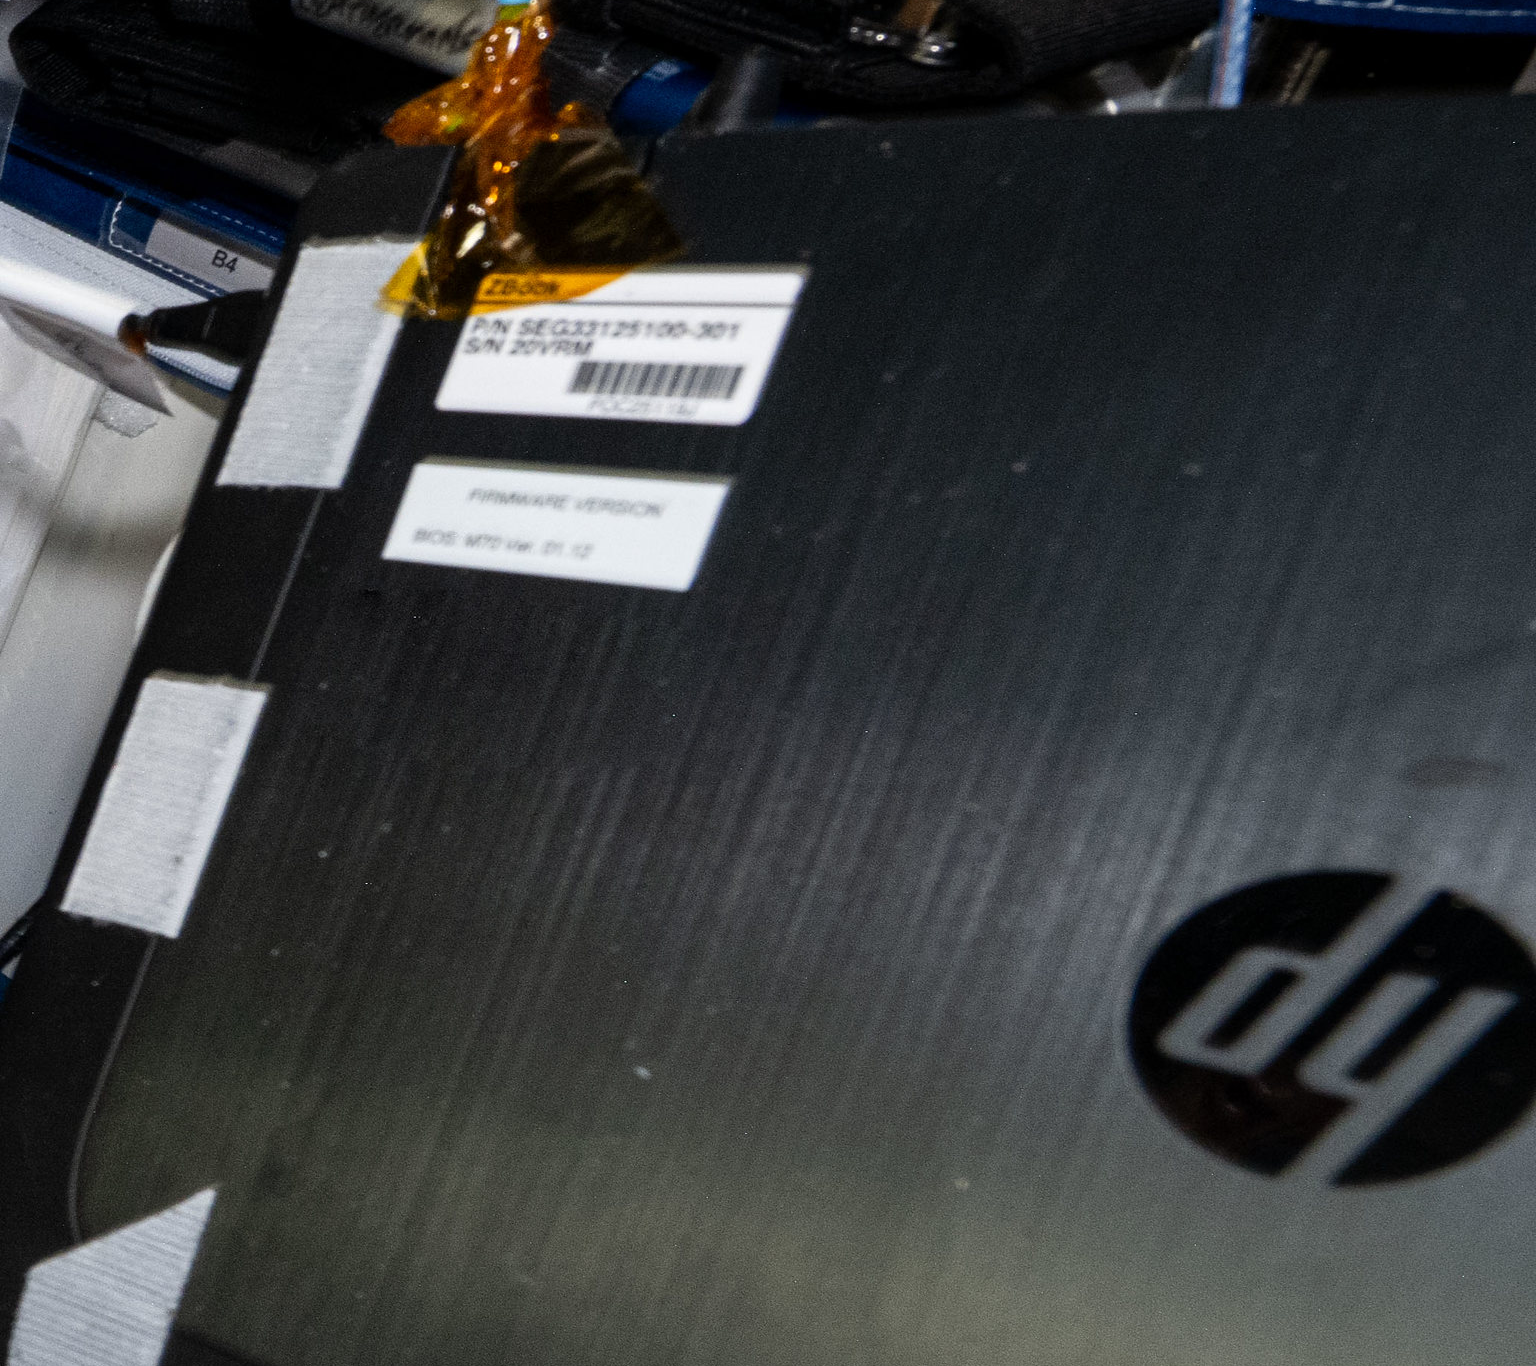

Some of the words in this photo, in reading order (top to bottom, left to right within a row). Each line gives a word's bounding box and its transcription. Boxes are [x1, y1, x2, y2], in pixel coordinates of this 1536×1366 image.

[210, 246, 239, 274] B4
[470, 317, 512, 337] P/N
[462, 336, 505, 355] S/N
[467, 488, 567, 512] FIRMWARE
[574, 497, 666, 519] VERSION
[1157, 872, 1523, 1185] hp
